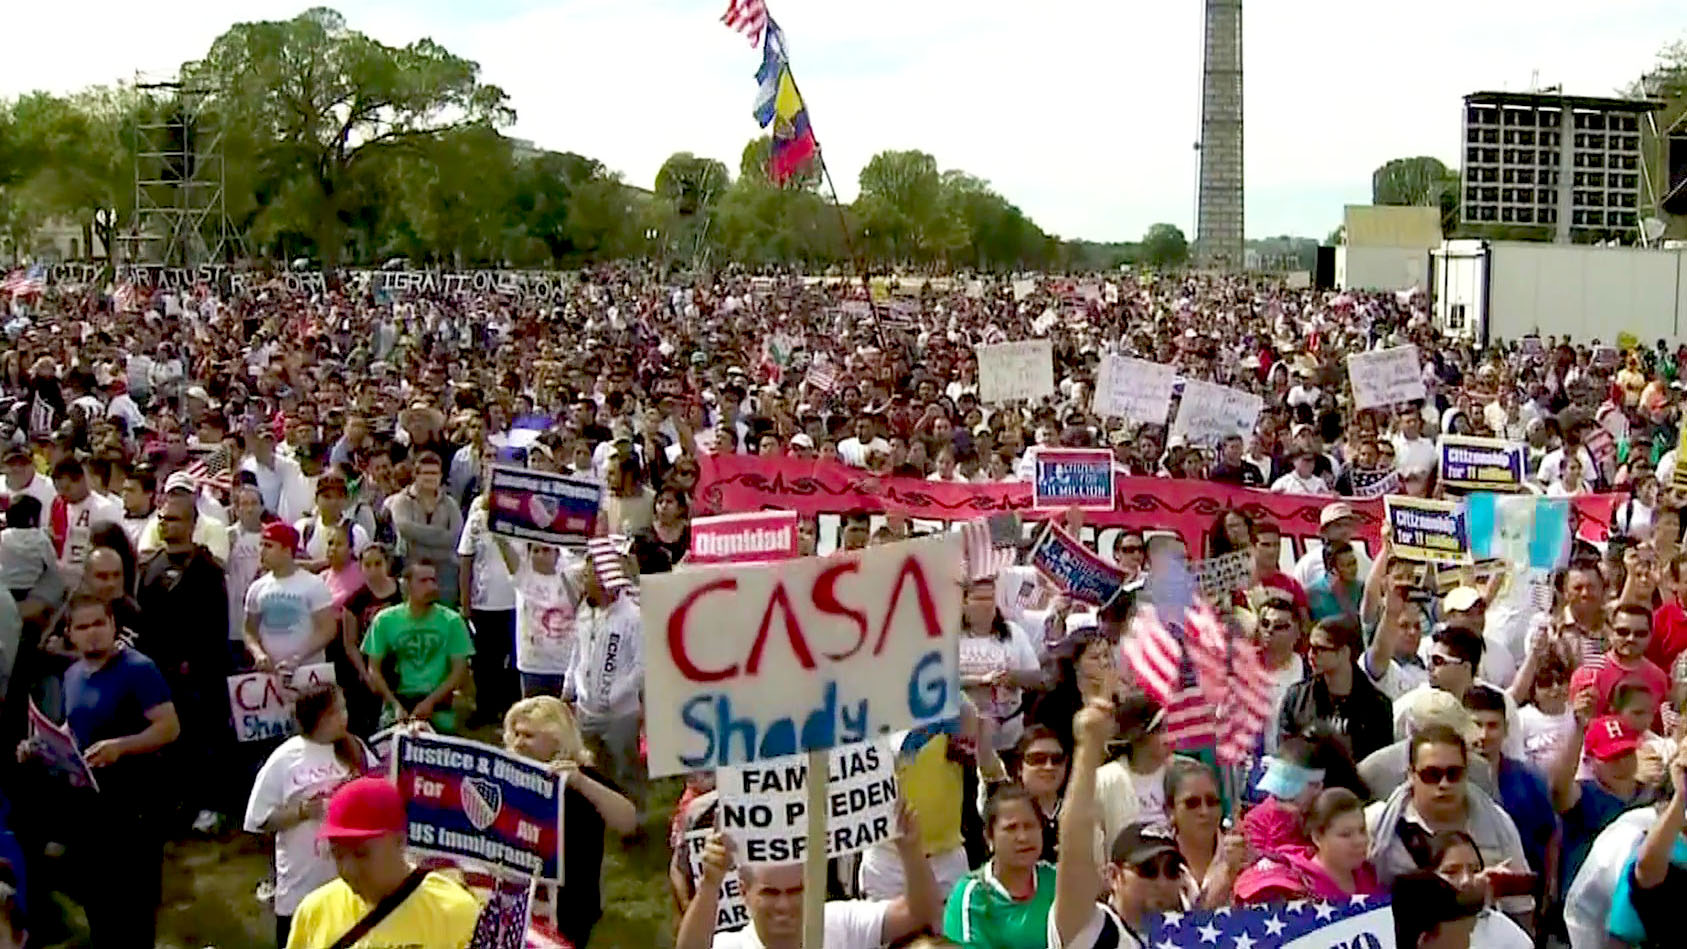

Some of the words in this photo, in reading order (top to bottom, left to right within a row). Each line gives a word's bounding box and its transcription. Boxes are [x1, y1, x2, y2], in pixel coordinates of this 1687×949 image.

[1060, 485, 1105, 497] MILLION
[667, 554, 943, 682] CASA
[908, 651, 948, 720] G
[404, 741, 475, 771] Justice
[477, 756, 491, 774] &
[413, 776, 446, 799] For
[723, 804, 773, 828] NO
[785, 777, 897, 826] PEDEN
[409, 821, 436, 845] US
[438, 827, 545, 876] Immigrants
